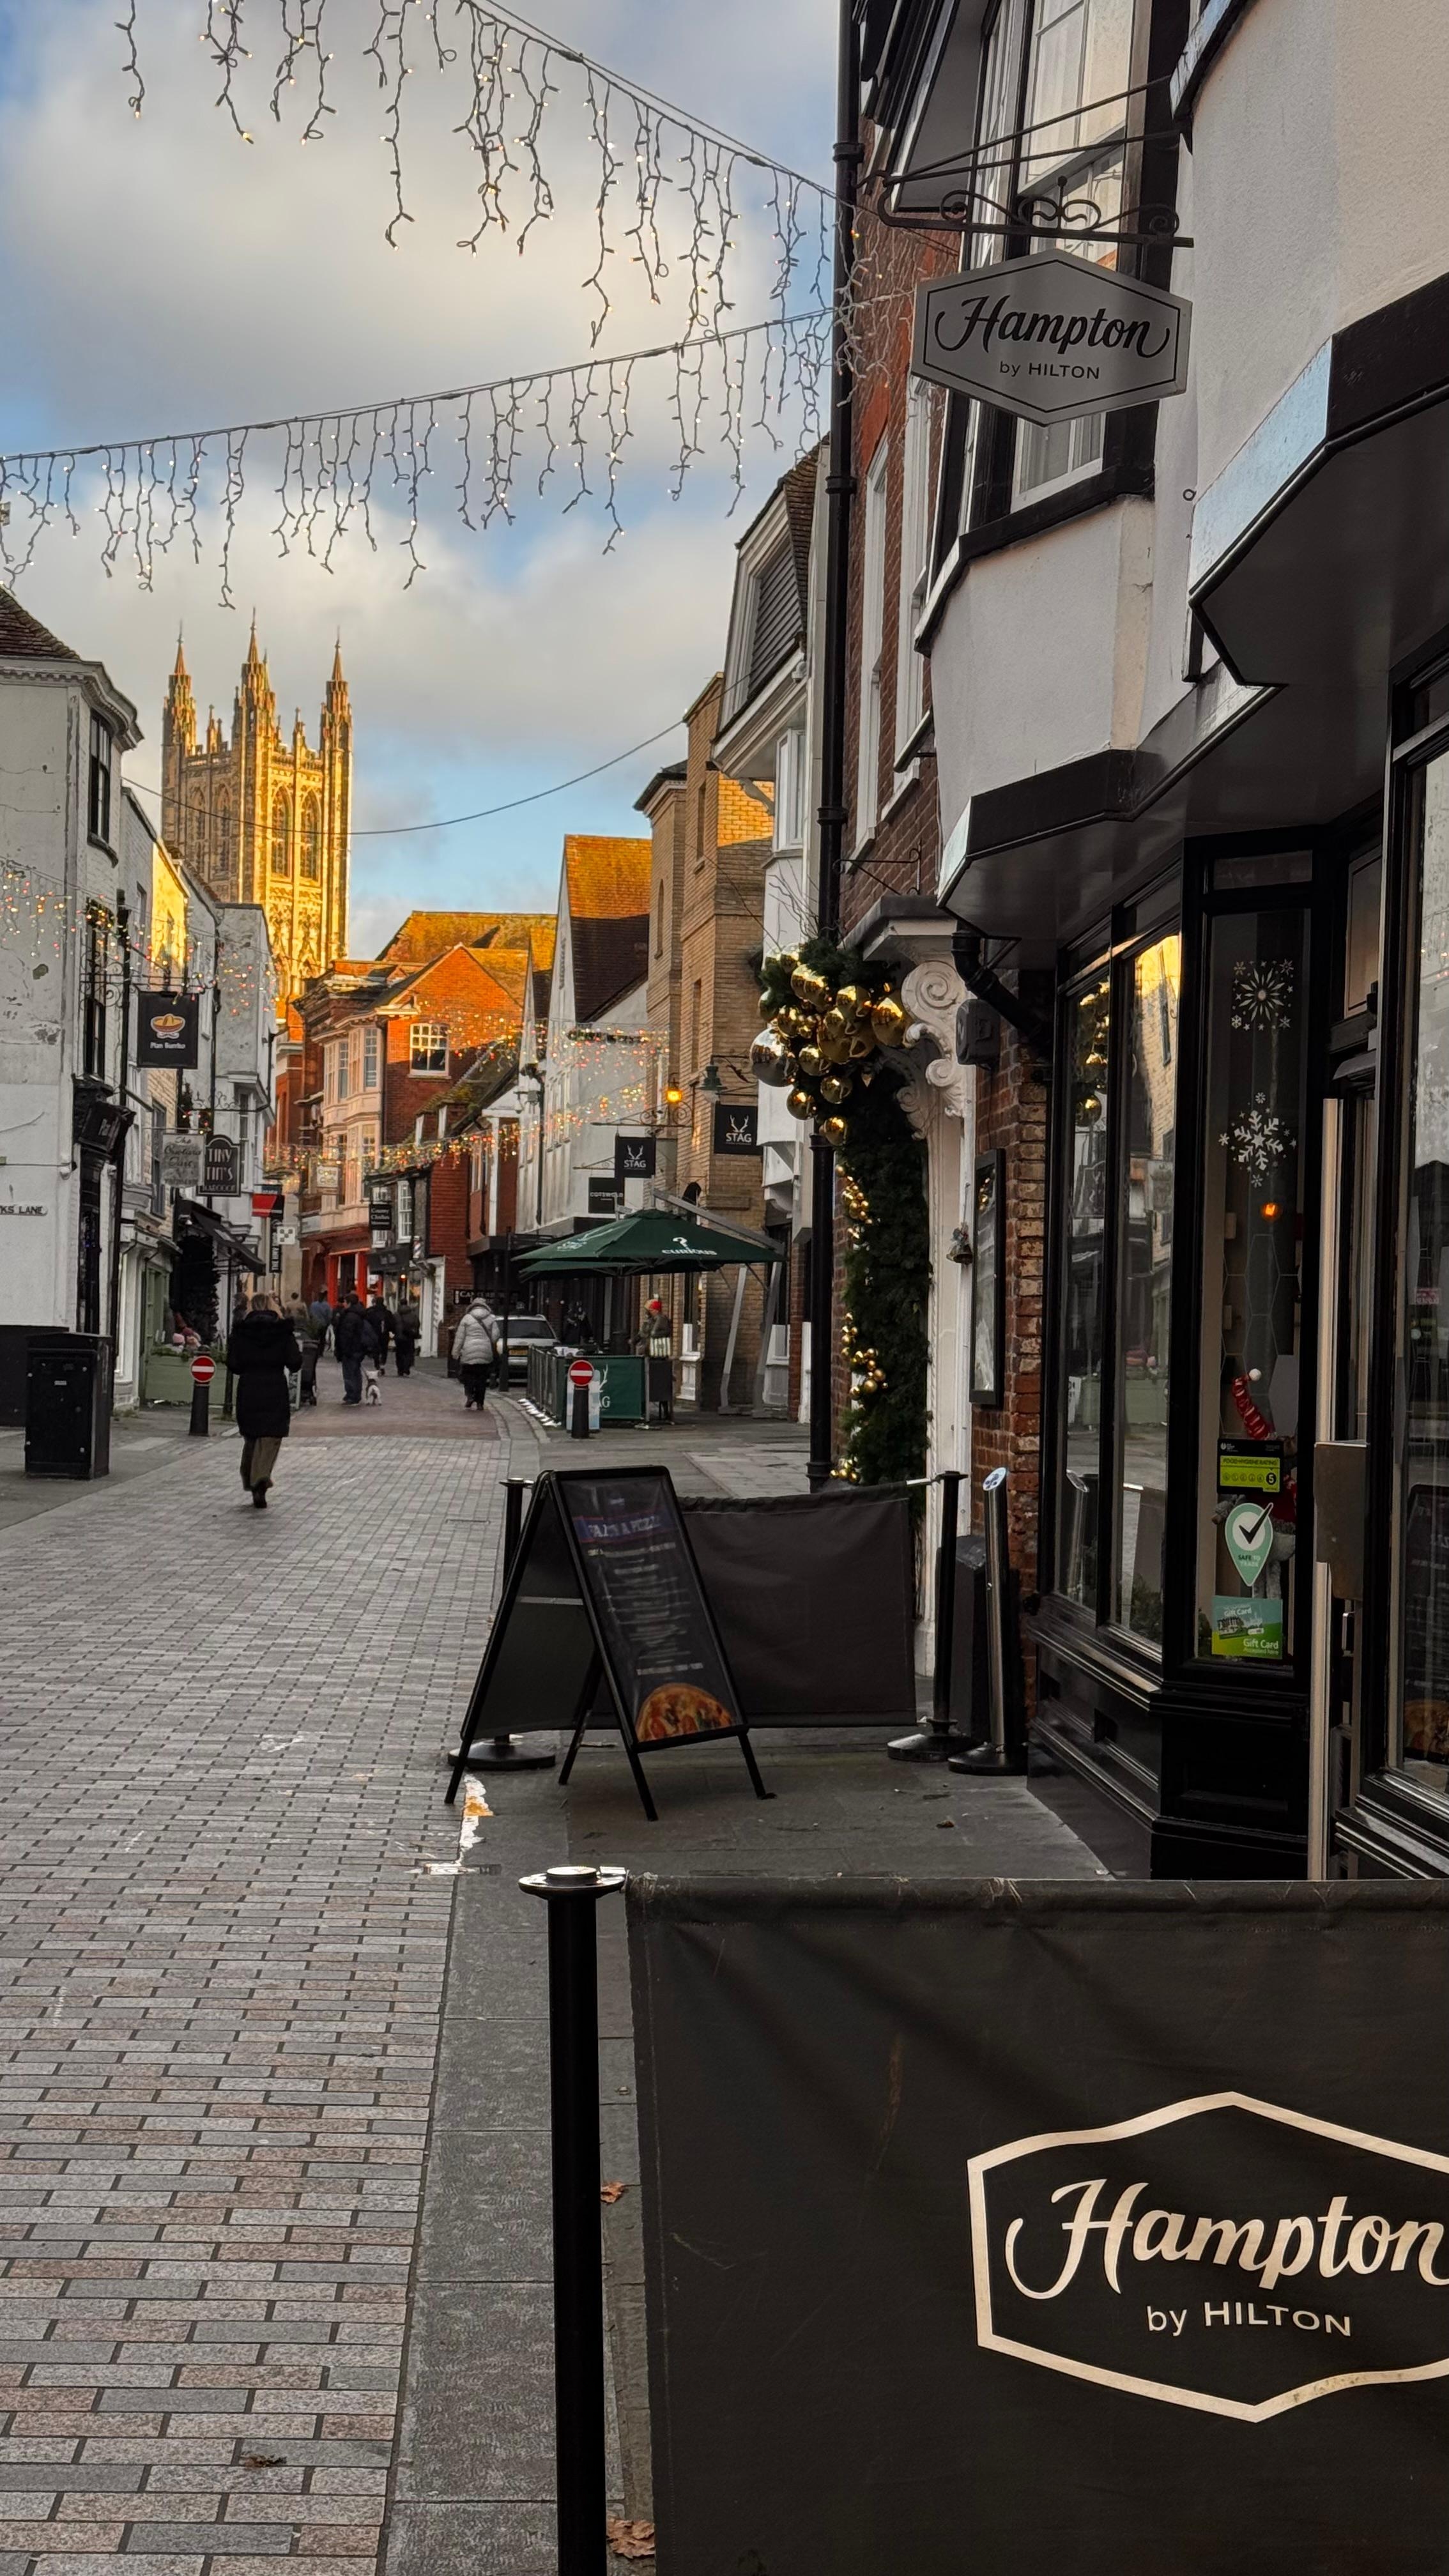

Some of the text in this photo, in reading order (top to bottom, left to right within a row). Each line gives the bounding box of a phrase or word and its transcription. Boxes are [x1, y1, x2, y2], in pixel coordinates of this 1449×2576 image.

[934, 295, 1170, 358] Hampton
[999, 361, 1100, 379] by HILTON
[725, 1132, 752, 1142] STAG
[209, 1149, 232, 1162] TINY
[624, 1159, 647, 1168] STAG
[19, 1206, 43, 1215] LANE
[1268, 1474, 1275, 1483] 5
[1236, 1607, 1252, 1616] Card
[1243, 1638, 1279, 1650] Gift Card
[1004, 2179, 1449, 2299] Hampton
[1147, 2301, 1351, 2336] by HILTON
